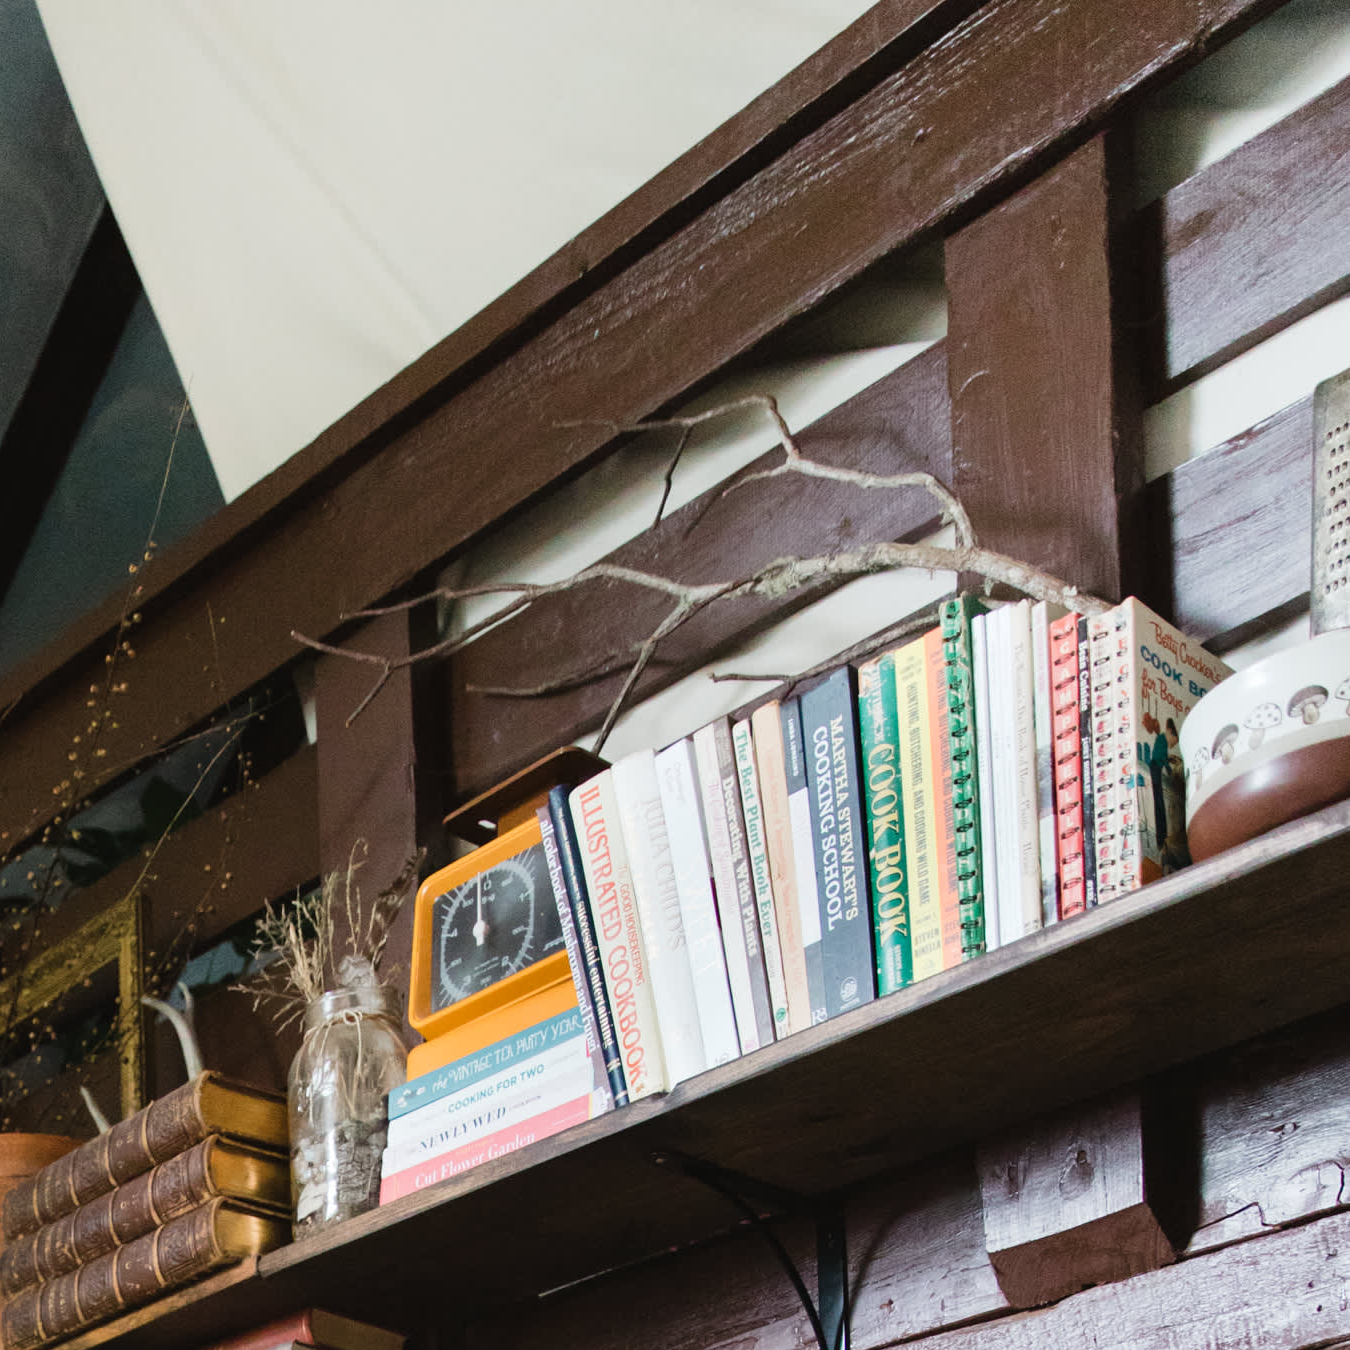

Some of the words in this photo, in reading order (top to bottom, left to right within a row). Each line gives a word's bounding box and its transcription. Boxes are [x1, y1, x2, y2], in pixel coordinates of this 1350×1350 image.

[1079, 641, 1089, 670] Bean
[1140, 645, 1183, 686] COOK
[1149, 621, 1179, 664] Betty
[1178, 643, 1222, 685] Crocker's
[906, 682, 920, 727] HUNTING,
[1080, 671, 1091, 713] Cuisine
[1141, 667, 1158, 701] for
[1157, 677, 1184, 718] Boys
[736, 730, 749, 762] The
[830, 714, 849, 808] MARTHA
[909, 727, 923, 790] BUTCHERING,
[740, 766, 754, 801] Best
[813, 725, 835, 835] COOKING
[868, 743, 900, 842] COOK
[914, 790, 924, 810] AND
[540, 819, 554, 837] all
[722, 774, 744, 863] Decorating
[745, 804, 762, 850] Plant
[914, 807, 927, 854] COOKING
[542, 835, 559, 869] color
[641, 796, 671, 859] JULIA
[657, 862, 687, 951] CHILD'S
[753, 852, 771, 896] Book
[838, 806, 859, 921] STEWART'S
[916, 853, 930, 880] WILD
[550, 864, 567, 903] book
[620, 883, 634, 912] GOOD
[736, 859, 752, 906] With
[821, 834, 843, 931] SCHOOL
[875, 840, 907, 947] BOOK
[918, 878, 931, 907] GAME
[557, 901, 571, 917] of
[742, 903, 759, 957] Plants
[760, 899, 773, 937] Ever
[559, 910, 583, 993] Mushrooms
[579, 784, 623, 941] ILLUSTRATED
[608, 944, 647, 1086] COOKBOOK
[624, 911, 645, 986] HOUSEKEEPING
[576, 900, 600, 966] successful
[589, 965, 615, 1049] entertaining
[577, 988, 592, 1013] and
[432, 1076, 449, 1093] the
[450, 1051, 493, 1083] VINTAGE
[494, 1043, 514, 1065] TEA
[515, 1028, 548, 1055] PARTY
[550, 1014, 585, 1041] YEAR
[583, 1010, 600, 1053] Fungi
[448, 1083, 494, 1113] COOKING
[496, 1076, 517, 1092] FOR
[520, 1063, 545, 1081] TWO
[419, 1106, 507, 1152] NEWLYWED
[414, 1170, 438, 1188] Cut
[440, 1150, 485, 1179] Flower
[487, 1132, 536, 1159] Garden
